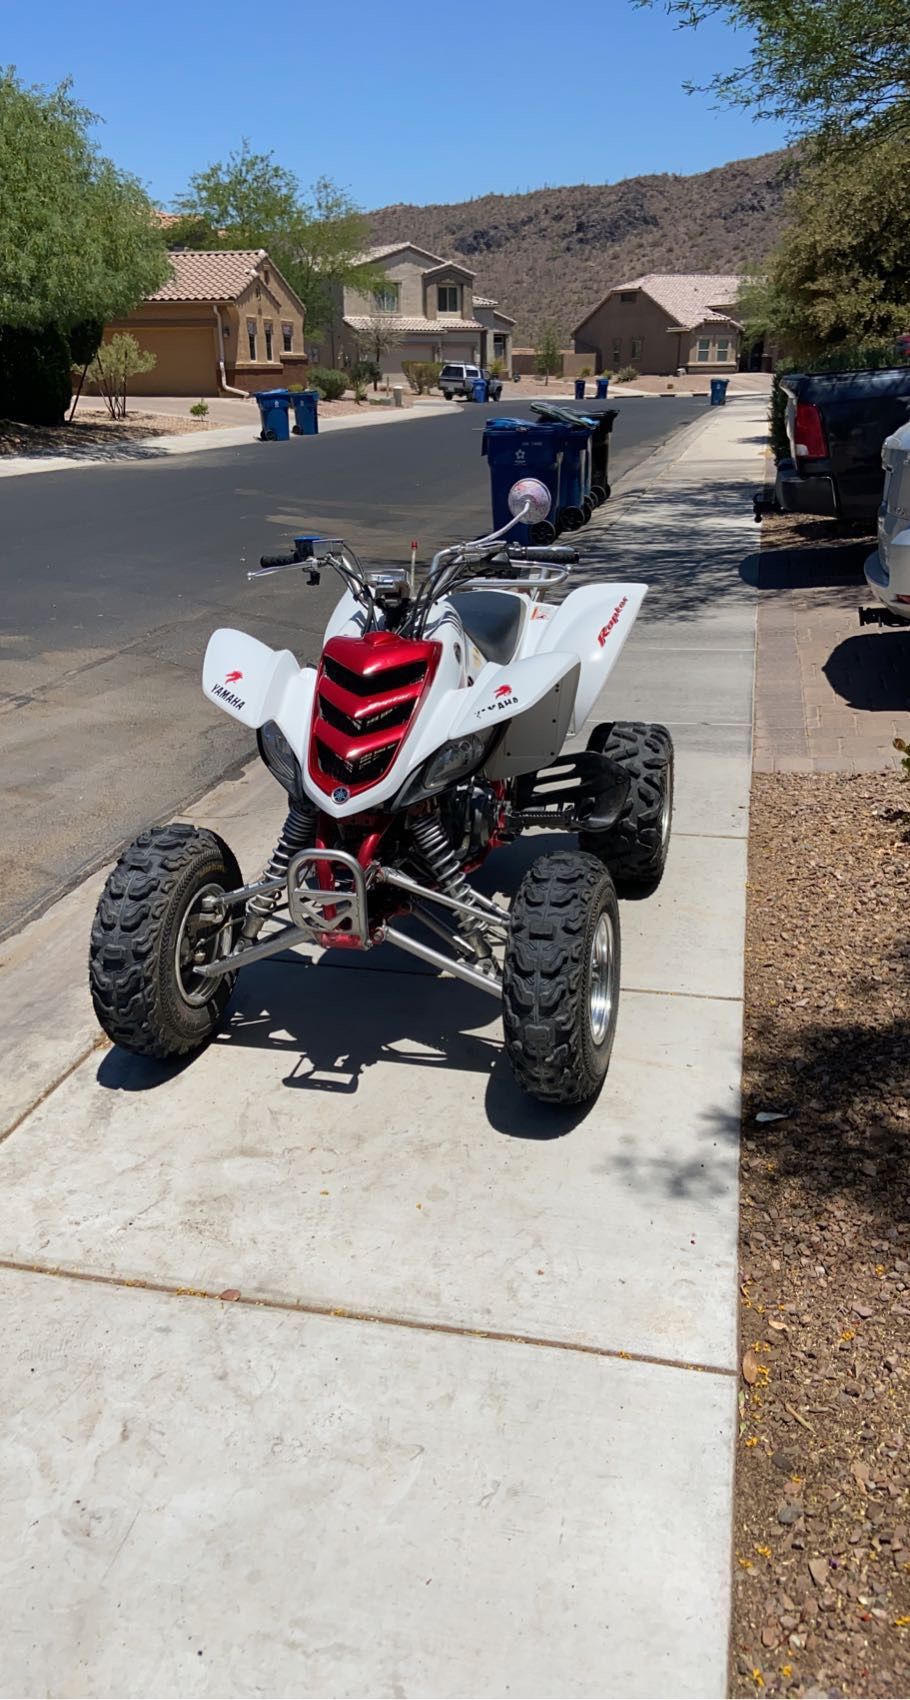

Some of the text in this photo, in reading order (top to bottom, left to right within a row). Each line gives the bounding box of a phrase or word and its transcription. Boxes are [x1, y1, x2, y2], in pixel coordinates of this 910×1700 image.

[598, 595, 628, 648] Raptor
[211, 683, 245, 710] YAMAHA
[474, 697, 518, 719] YMAHA
